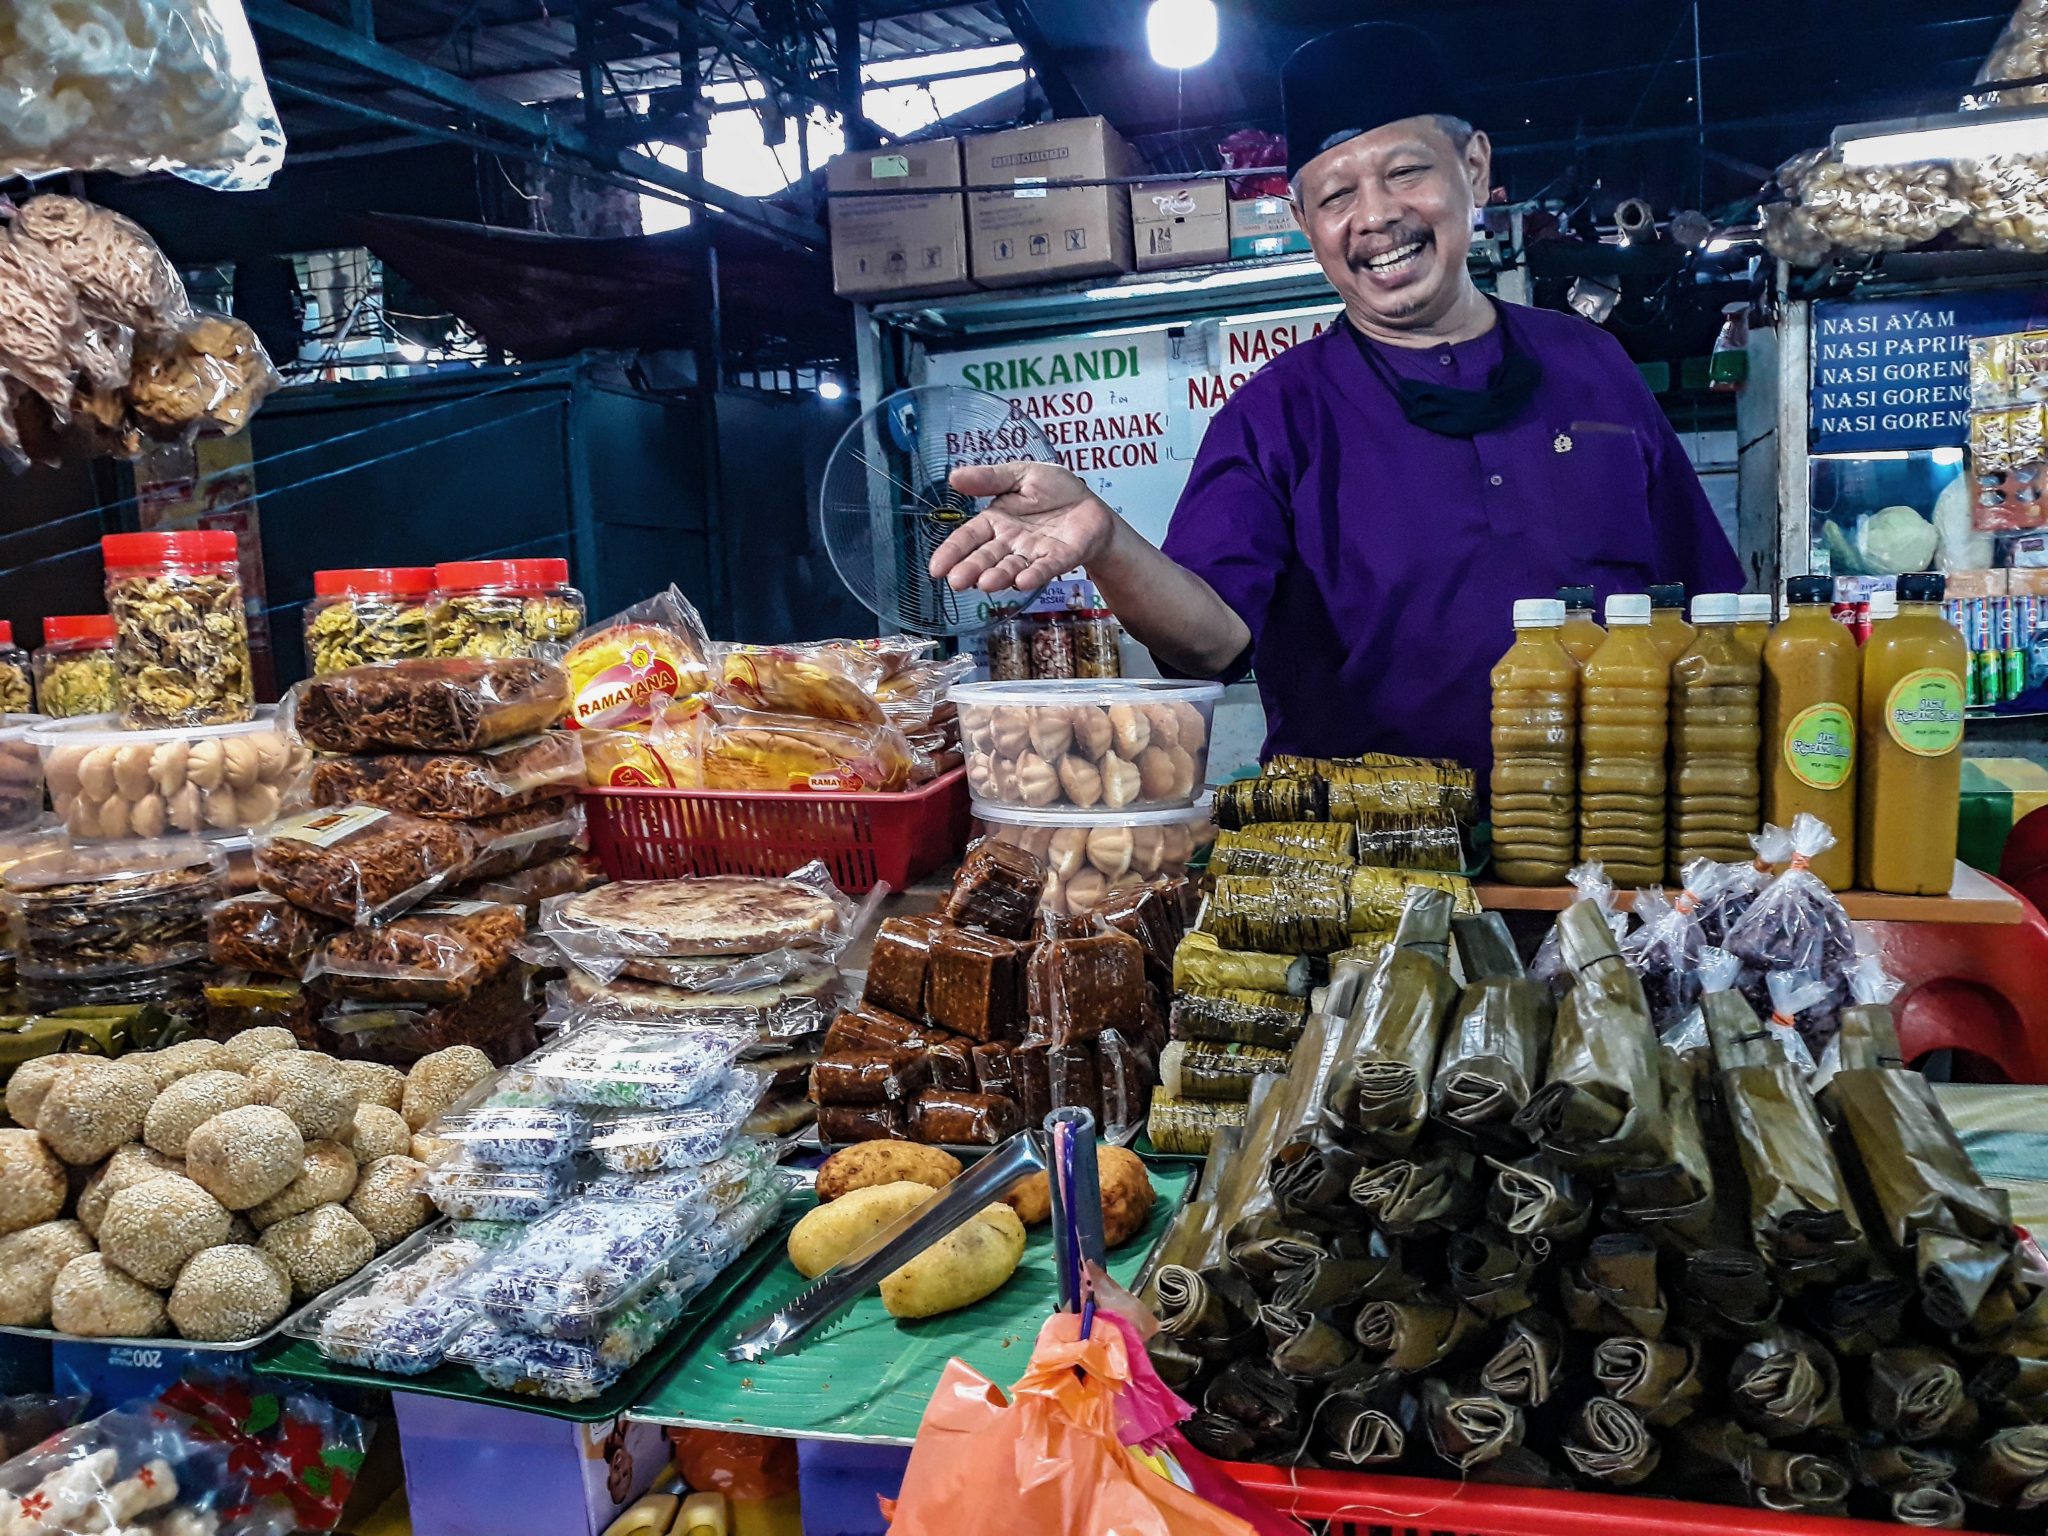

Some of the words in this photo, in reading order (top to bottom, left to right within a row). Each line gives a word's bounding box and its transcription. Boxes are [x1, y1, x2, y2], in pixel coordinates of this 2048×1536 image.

[1158, 227, 1171, 240] 24
[1823, 316, 1878, 335] NASI
[1885, 310, 1955, 331] AYAM
[1229, 325, 1297, 364] NASI
[1823, 341, 1877, 360] NASI
[962, 346, 1140, 391] SRIKANDI
[1822, 366, 1877, 384] NASI
[1188, 372, 1254, 409] NAS
[1822, 391, 1876, 409] NASI
[1009, 391, 1093, 421] BAKSO
[946, 426, 1027, 455] BAKSO
[1044, 412, 1164, 446] BERANAK
[1822, 416, 1876, 433] NASI
[1055, 441, 1158, 472] MERCON
[577, 670, 675, 718] RAMAYANA
[132, 1349, 163, 1368] 200
